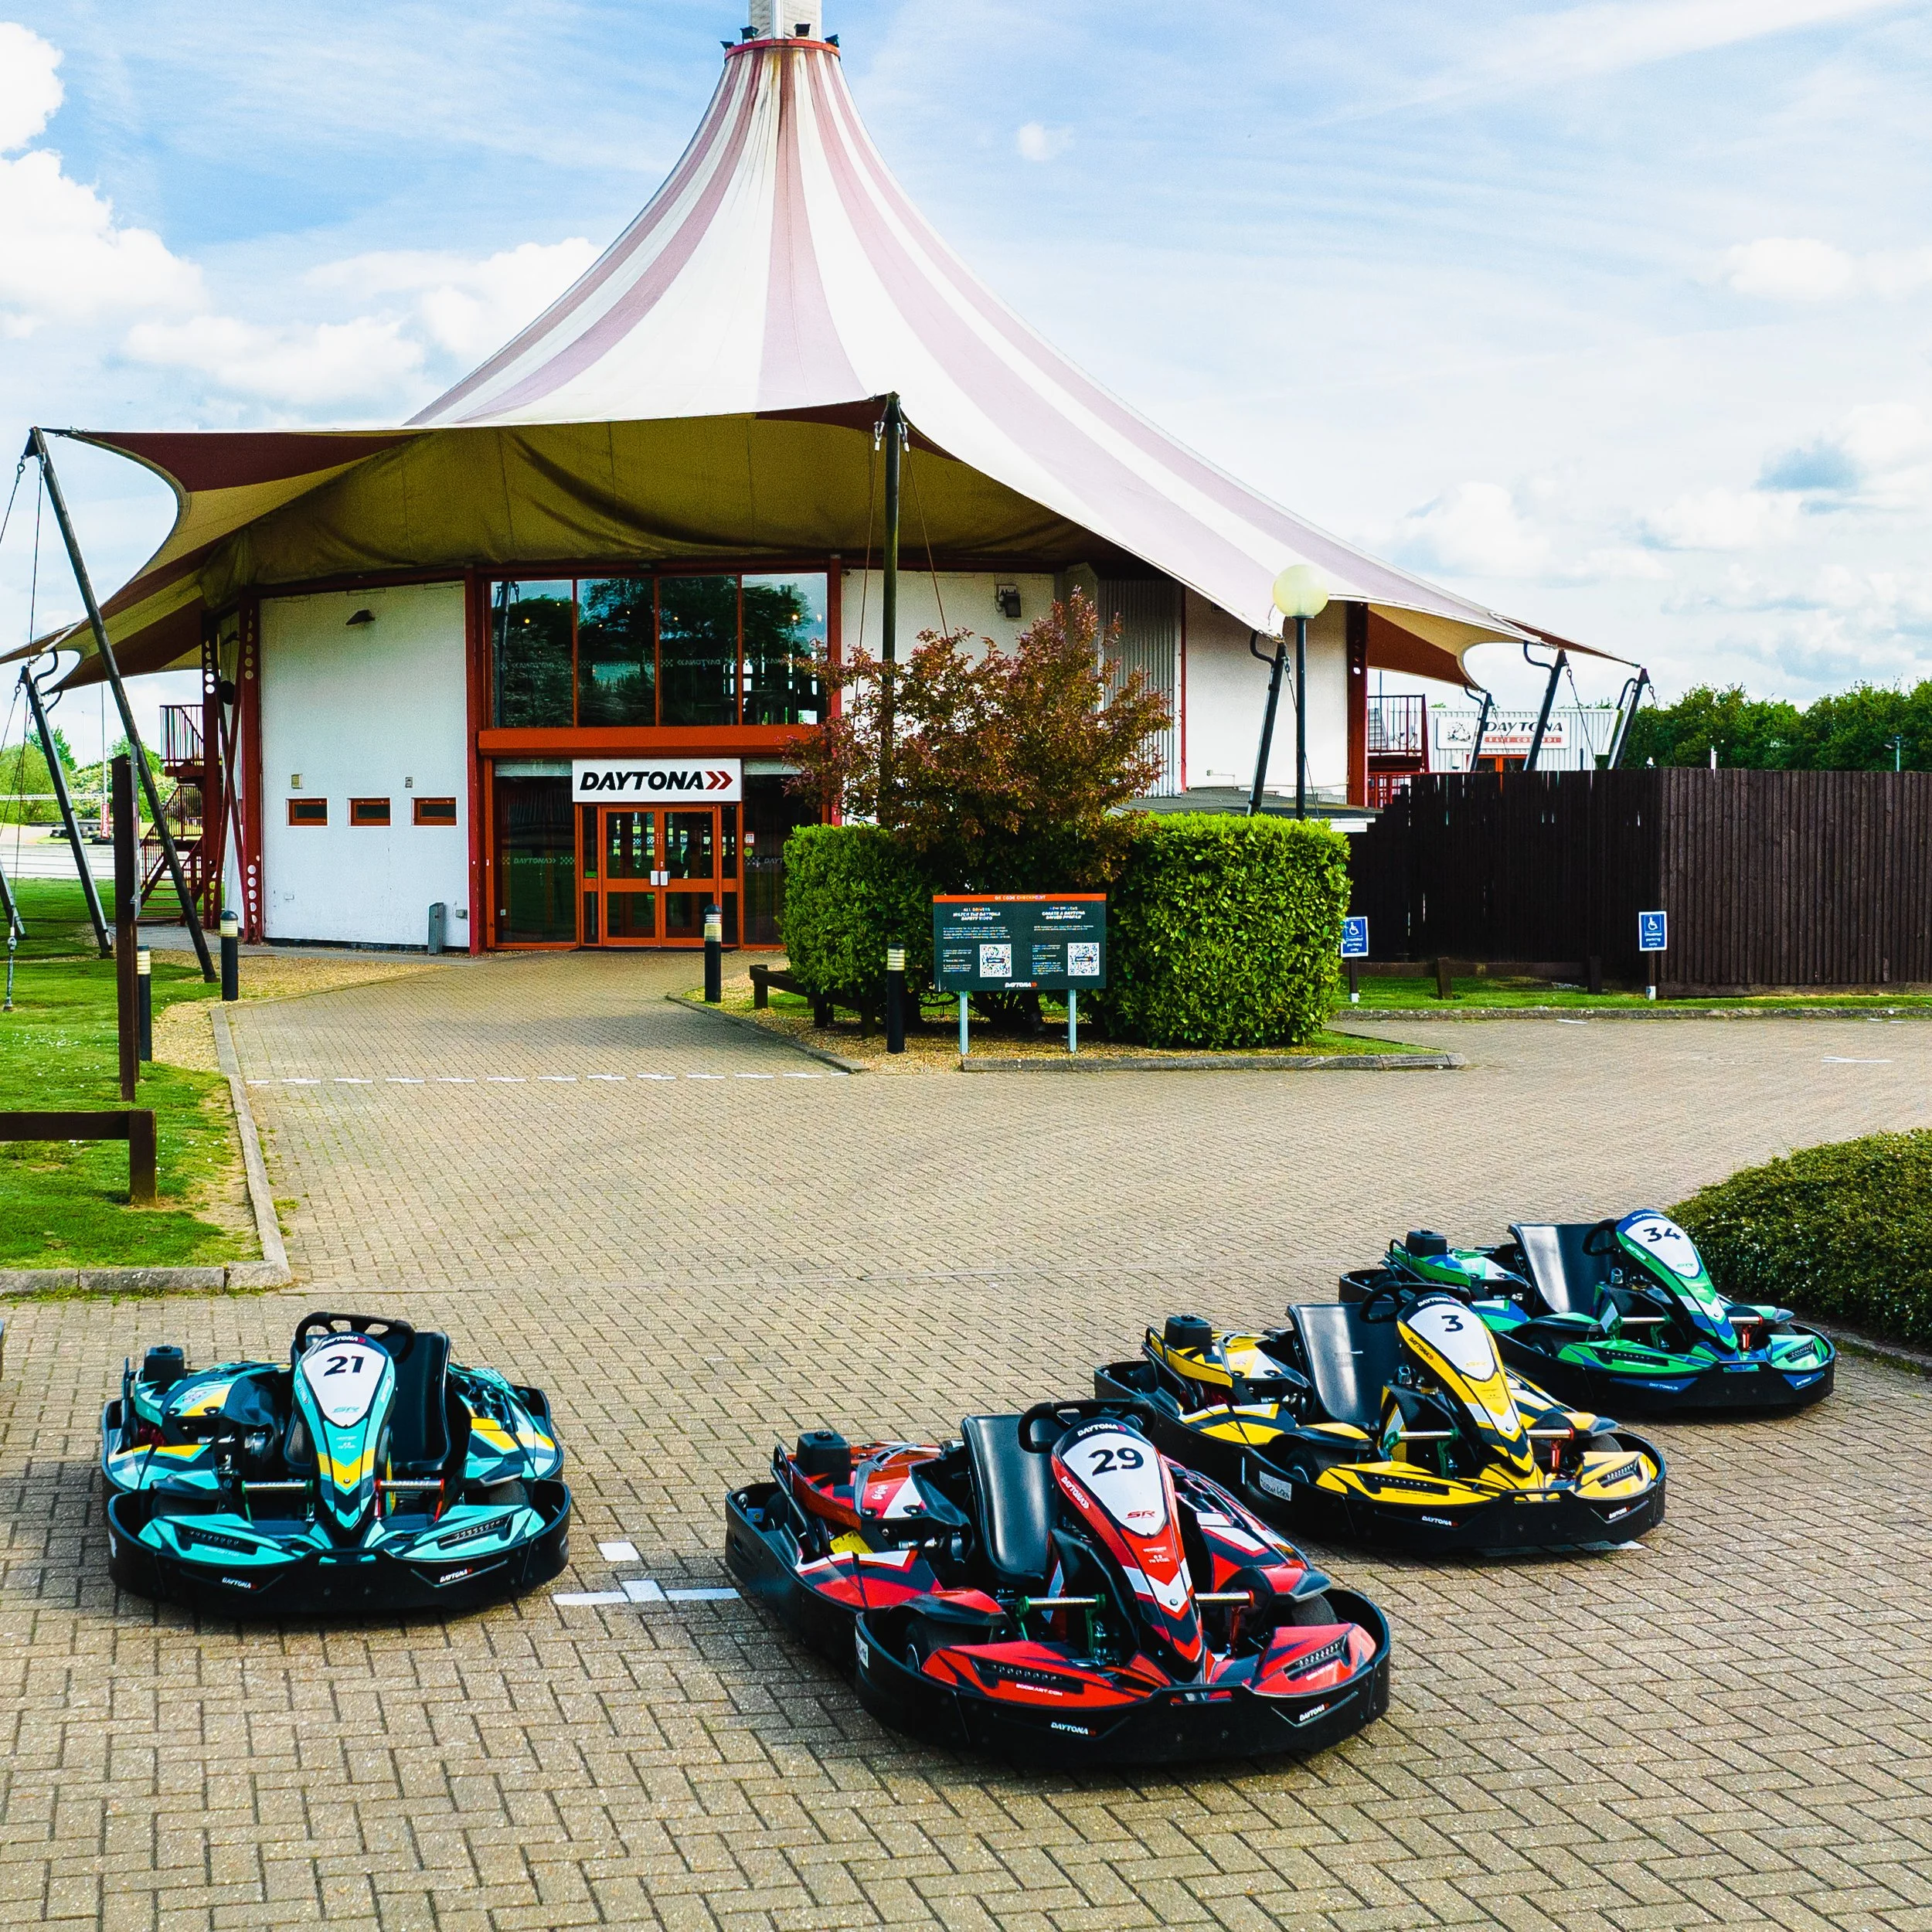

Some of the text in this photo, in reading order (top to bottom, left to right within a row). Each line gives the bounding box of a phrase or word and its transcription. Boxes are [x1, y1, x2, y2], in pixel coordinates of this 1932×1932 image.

[1485, 722, 1563, 736] DAYTONA
[580, 771, 704, 791] DAYTONA
[1643, 1227, 1682, 1243] 34
[1417, 1297, 1450, 1307] DAYTONA
[1441, 1315, 1464, 1332] 3
[321, 1336, 359, 1345] DAYTONA
[1408, 1337, 1430, 1359] DAYTONA
[324, 1355, 365, 1376] 21
[1077, 1423, 1119, 1437] DAYTONA
[1088, 1447, 1144, 1477] 29
[1061, 1475, 1086, 1507] DAYTONA
[1126, 1511, 1155, 1519] SR
[1422, 1515, 1452, 1526] DAYTONA
[222, 1577, 252, 1589] DAYTONA
[440, 1569, 468, 1583] DAYTONA
[1299, 1704, 1325, 1722] DAYTONA
[1051, 1722, 1089, 1736] DAYTONA
